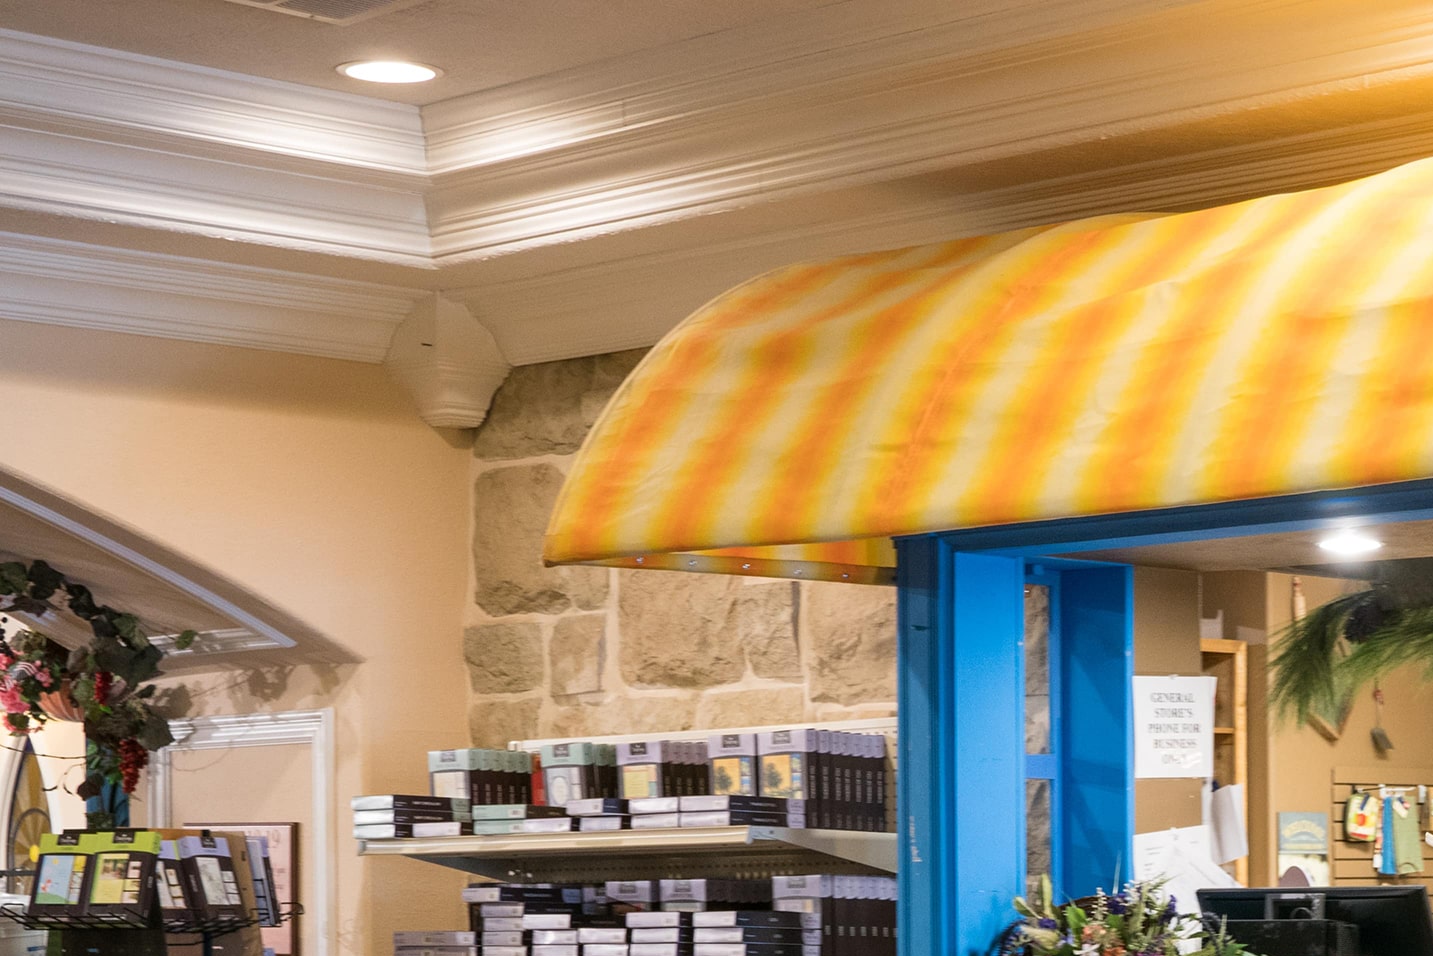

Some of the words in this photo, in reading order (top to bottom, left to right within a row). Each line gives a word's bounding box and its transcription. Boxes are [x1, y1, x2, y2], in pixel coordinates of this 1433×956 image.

[1150, 692, 1196, 703] GENERAL
[1153, 707, 1193, 718] STORE'S
[1147, 722, 1179, 734] PHONE
[1182, 722, 1201, 734] FOR
[1153, 738, 1197, 749] BUSINESS
